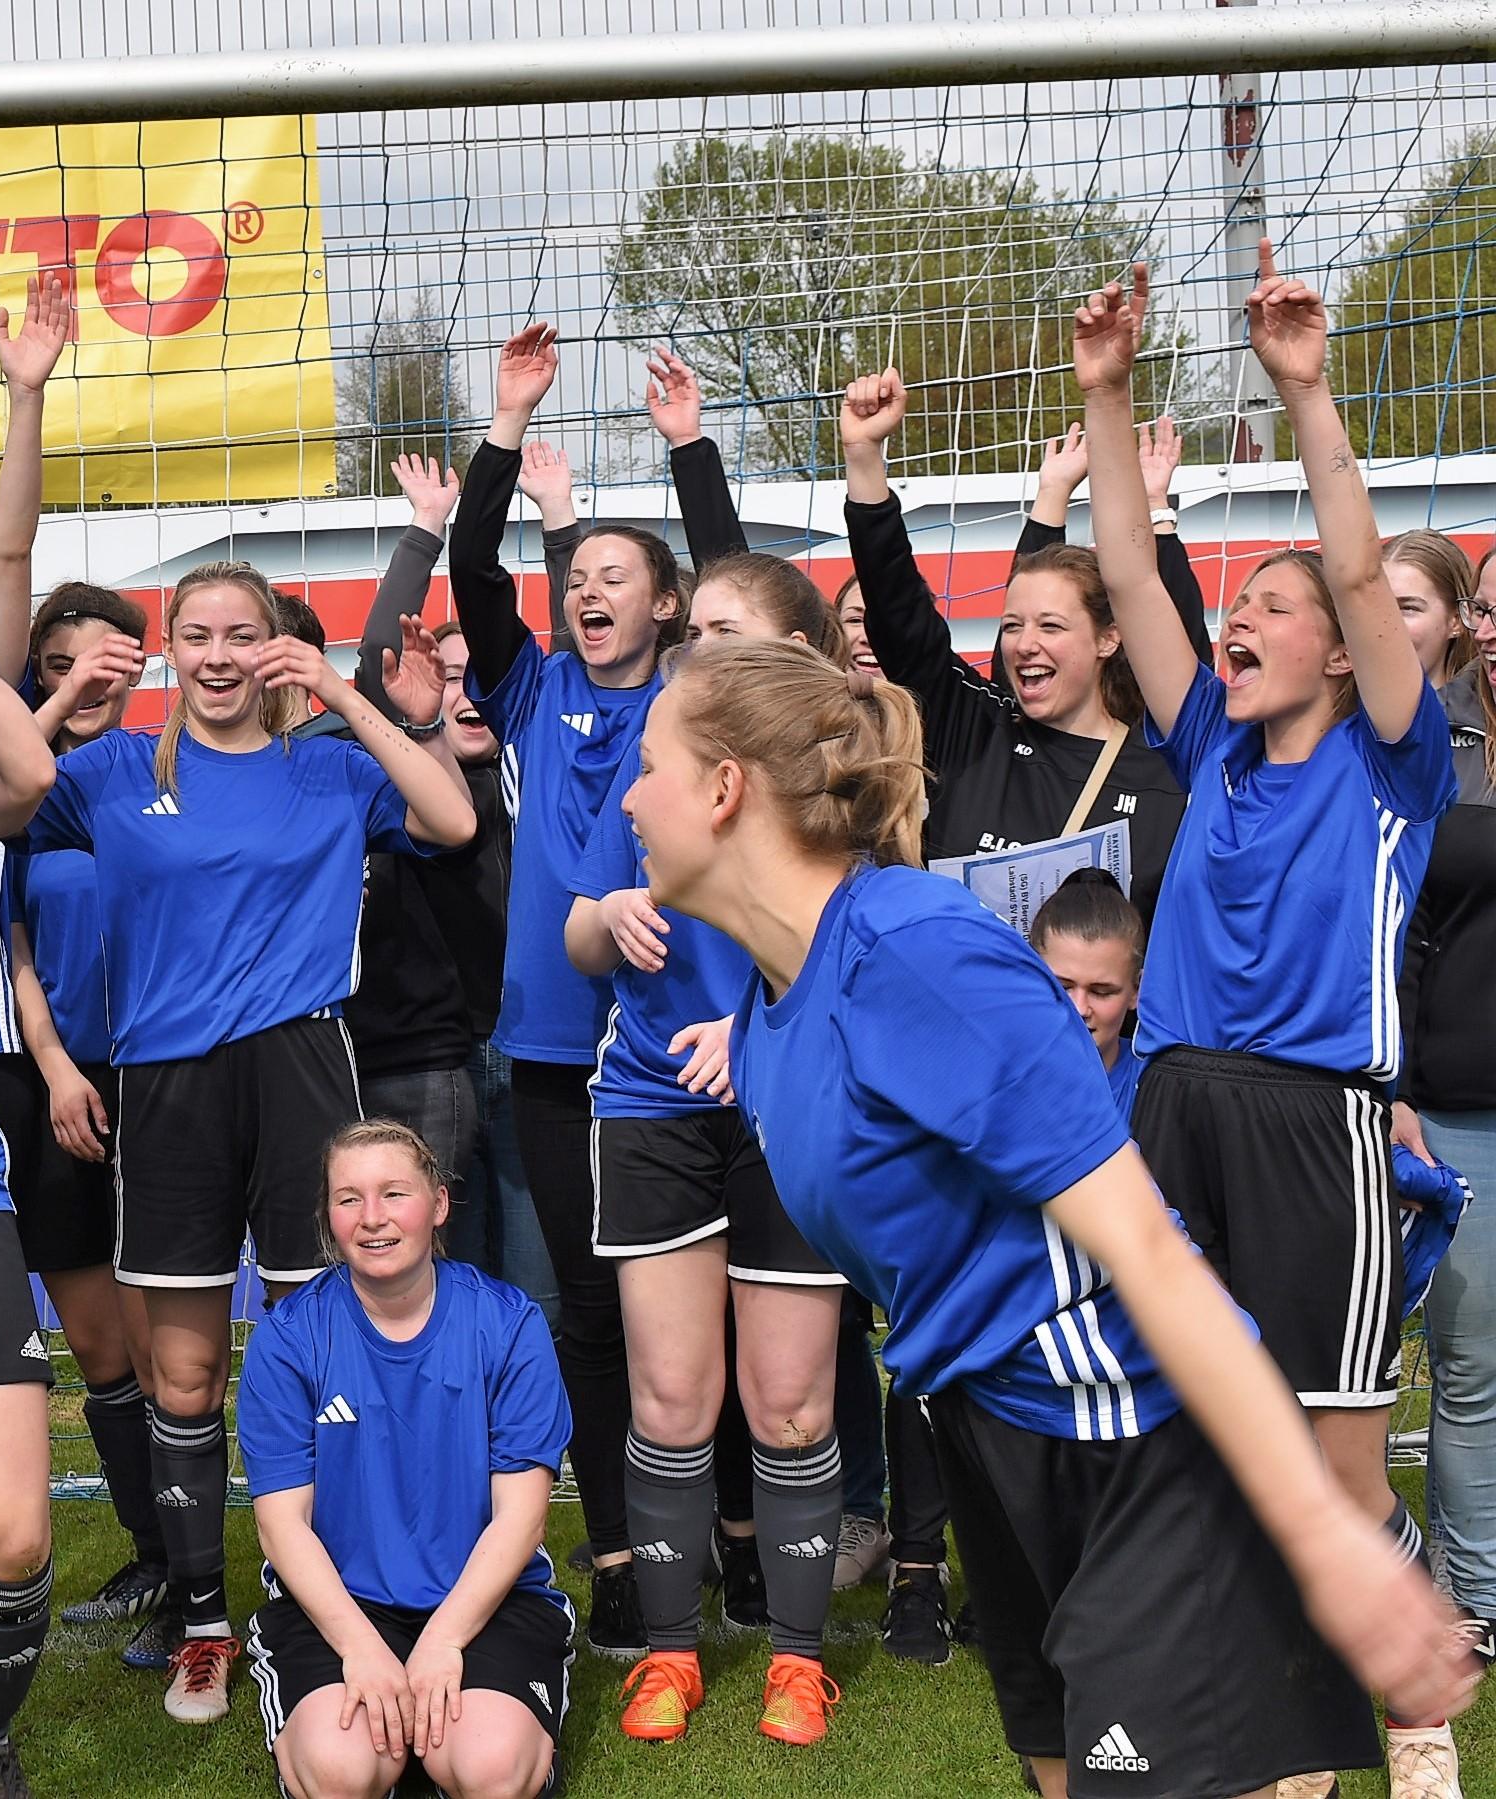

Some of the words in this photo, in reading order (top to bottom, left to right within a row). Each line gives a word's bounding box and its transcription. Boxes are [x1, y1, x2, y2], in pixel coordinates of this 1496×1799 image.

[1112, 793, 1138, 814] JH
[20, 1348, 49, 1361] adidas
[778, 1543, 834, 1558] adidas
[1085, 1754, 1150, 1772] adidas
